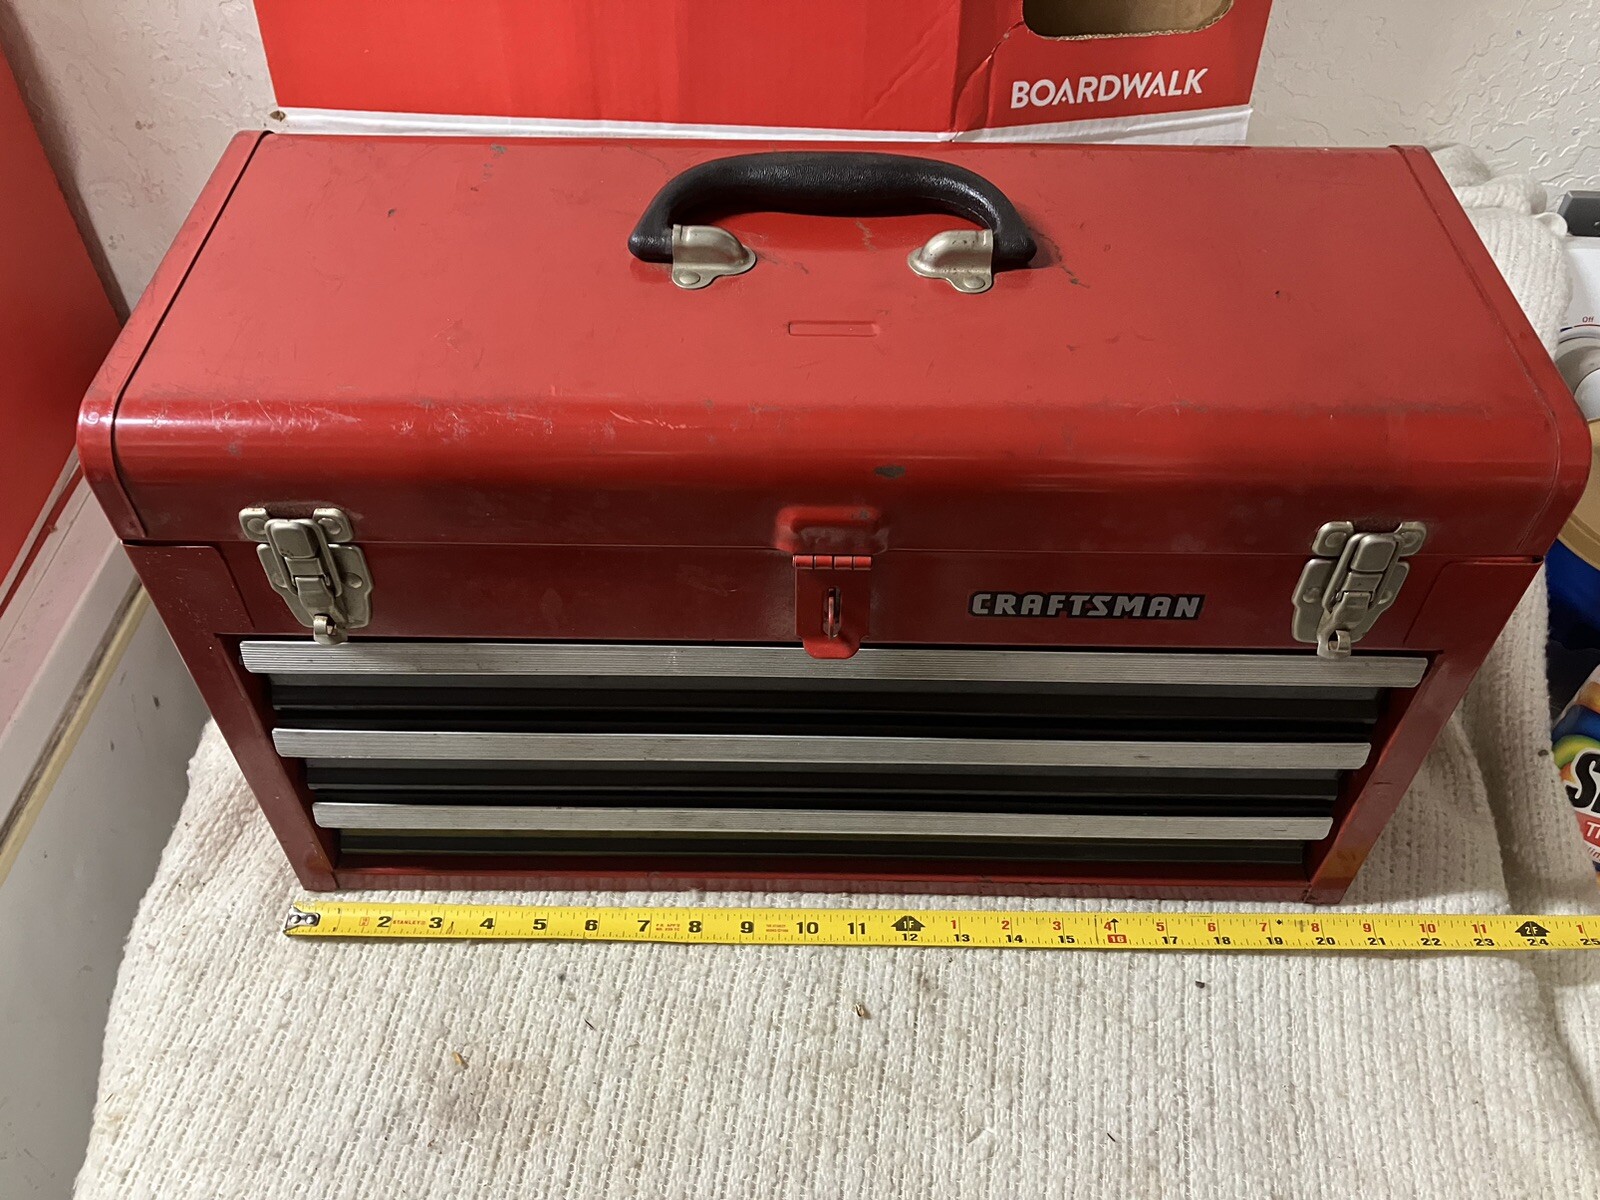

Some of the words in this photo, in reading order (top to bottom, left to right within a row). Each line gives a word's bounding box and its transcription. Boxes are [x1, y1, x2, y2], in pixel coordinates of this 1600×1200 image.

[1010, 67, 1208, 109] BOARDWALK
[971, 593, 1201, 618] CRAFTSMAN
[377, 916, 392, 928] 2
[428, 917, 443, 929] 3
[479, 918, 495, 929] 4
[533, 919, 547, 930] 5
[585, 920, 598, 931] 6
[637, 920, 651, 932] 7
[688, 921, 702, 933] 8
[740, 921, 754, 934] 9
[796, 922, 819, 934] 10
[847, 922, 866, 935] 11
[951, 920, 956, 929] 1
[1001, 920, 1010, 930] 2
[1052, 921, 1061, 930] 3
[1104, 921, 1112, 931] 4
[1156, 922, 1165, 931] 5
[1207, 922, 1216, 932] 6
[1259, 922, 1267, 932] 7
[1311, 923, 1320, 932] 8
[1363, 923, 1371, 932] 9
[1419, 923, 1436, 933] 10
[1471, 924, 1487, 933] 11
[1576, 924, 1583, 934] 1
[902, 933, 918, 941] 12
[954, 934, 970, 942] 13
[1006, 934, 1023, 943] 14
[1058, 935, 1075, 943] 15
[1109, 935, 1124, 943] 16
[1162, 936, 1178, 944] 17
[1213, 936, 1231, 945] 18
[1266, 937, 1283, 945] 19
[1315, 937, 1335, 945] 20
[1367, 937, 1386, 946] 21
[1420, 938, 1441, 946] 22
[1474, 938, 1495, 946] 23
[1527, 938, 1549, 946] 24
[1580, 938, 1600, 946] 25
